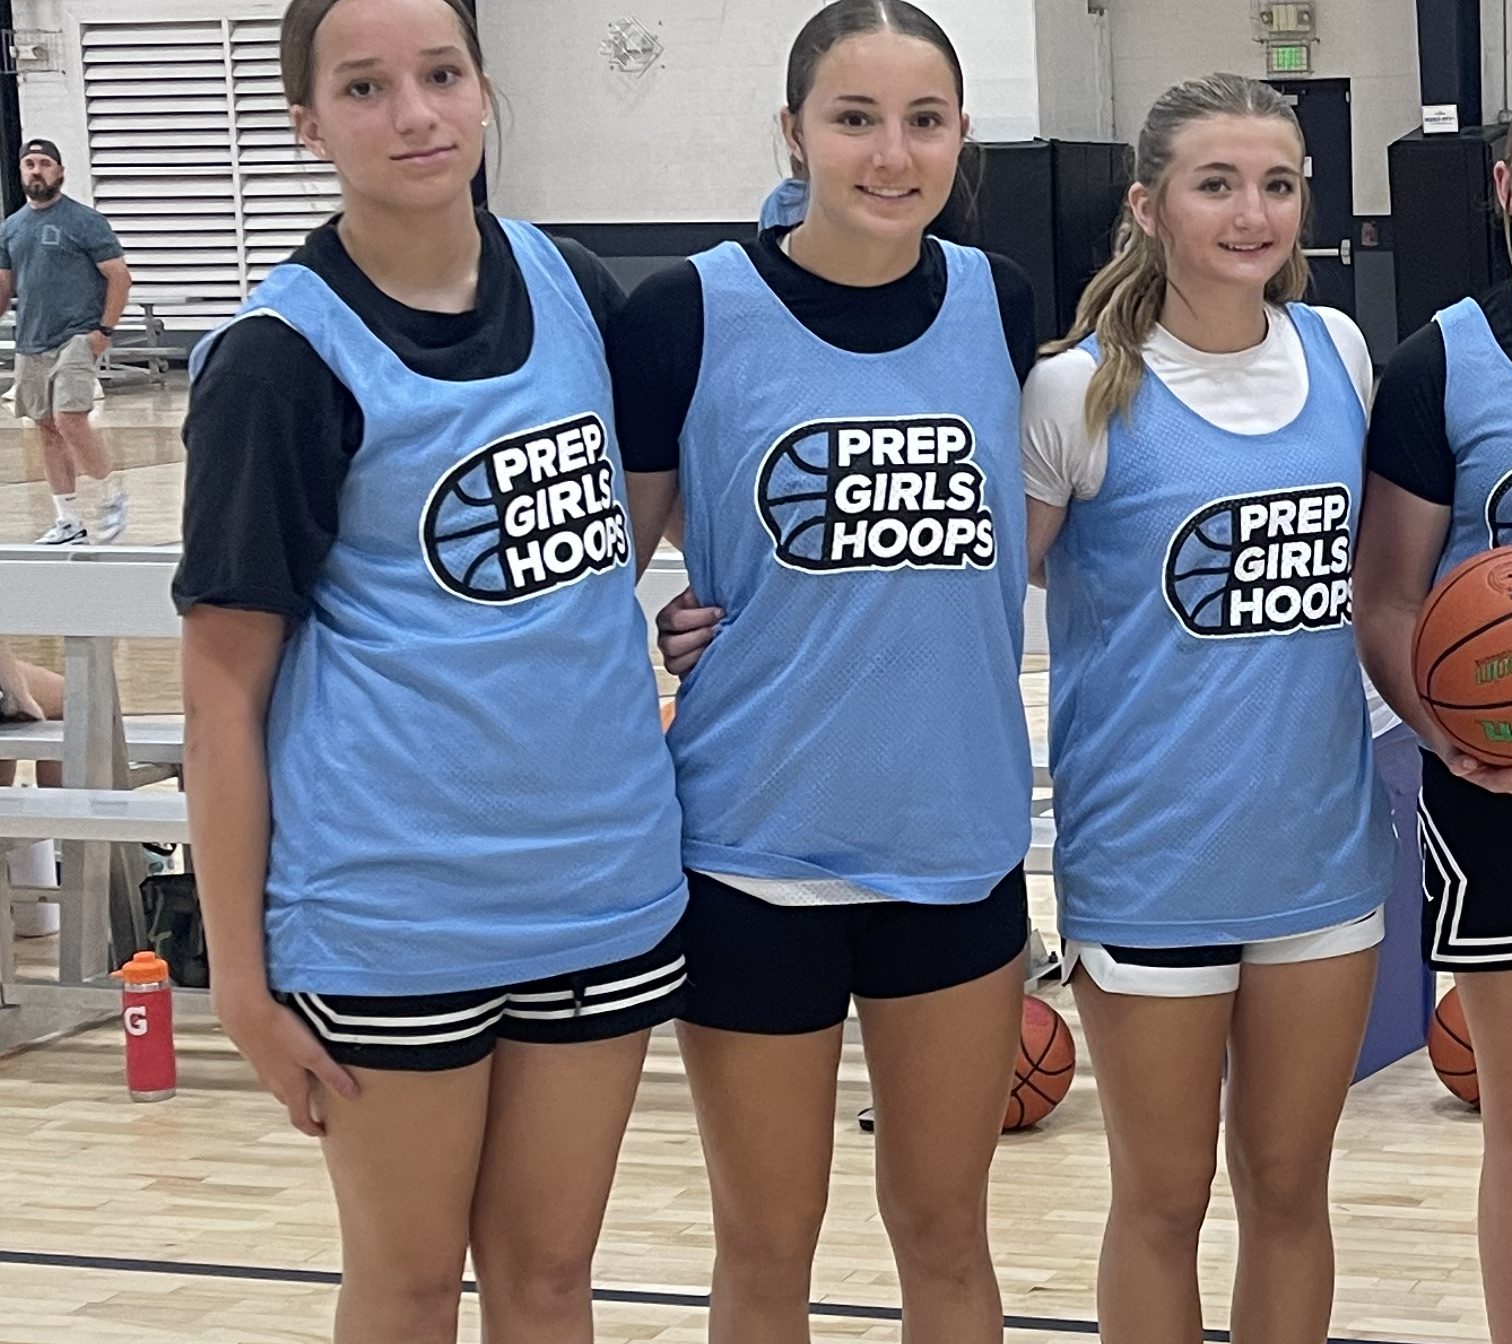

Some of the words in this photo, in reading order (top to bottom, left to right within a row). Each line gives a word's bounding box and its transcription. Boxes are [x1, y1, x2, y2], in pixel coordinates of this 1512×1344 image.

[493, 424, 602, 493] PREP
[838, 426, 966, 467] PREP
[505, 468, 612, 537] GIRLS
[834, 472, 975, 514] GIRLS
[830, 517, 993, 560] HOOPS
[1240, 494, 1346, 542] PREP
[505, 514, 626, 588] HOOPS
[1233, 536, 1349, 582] GIRLS
[124, 1006, 148, 1036] G
